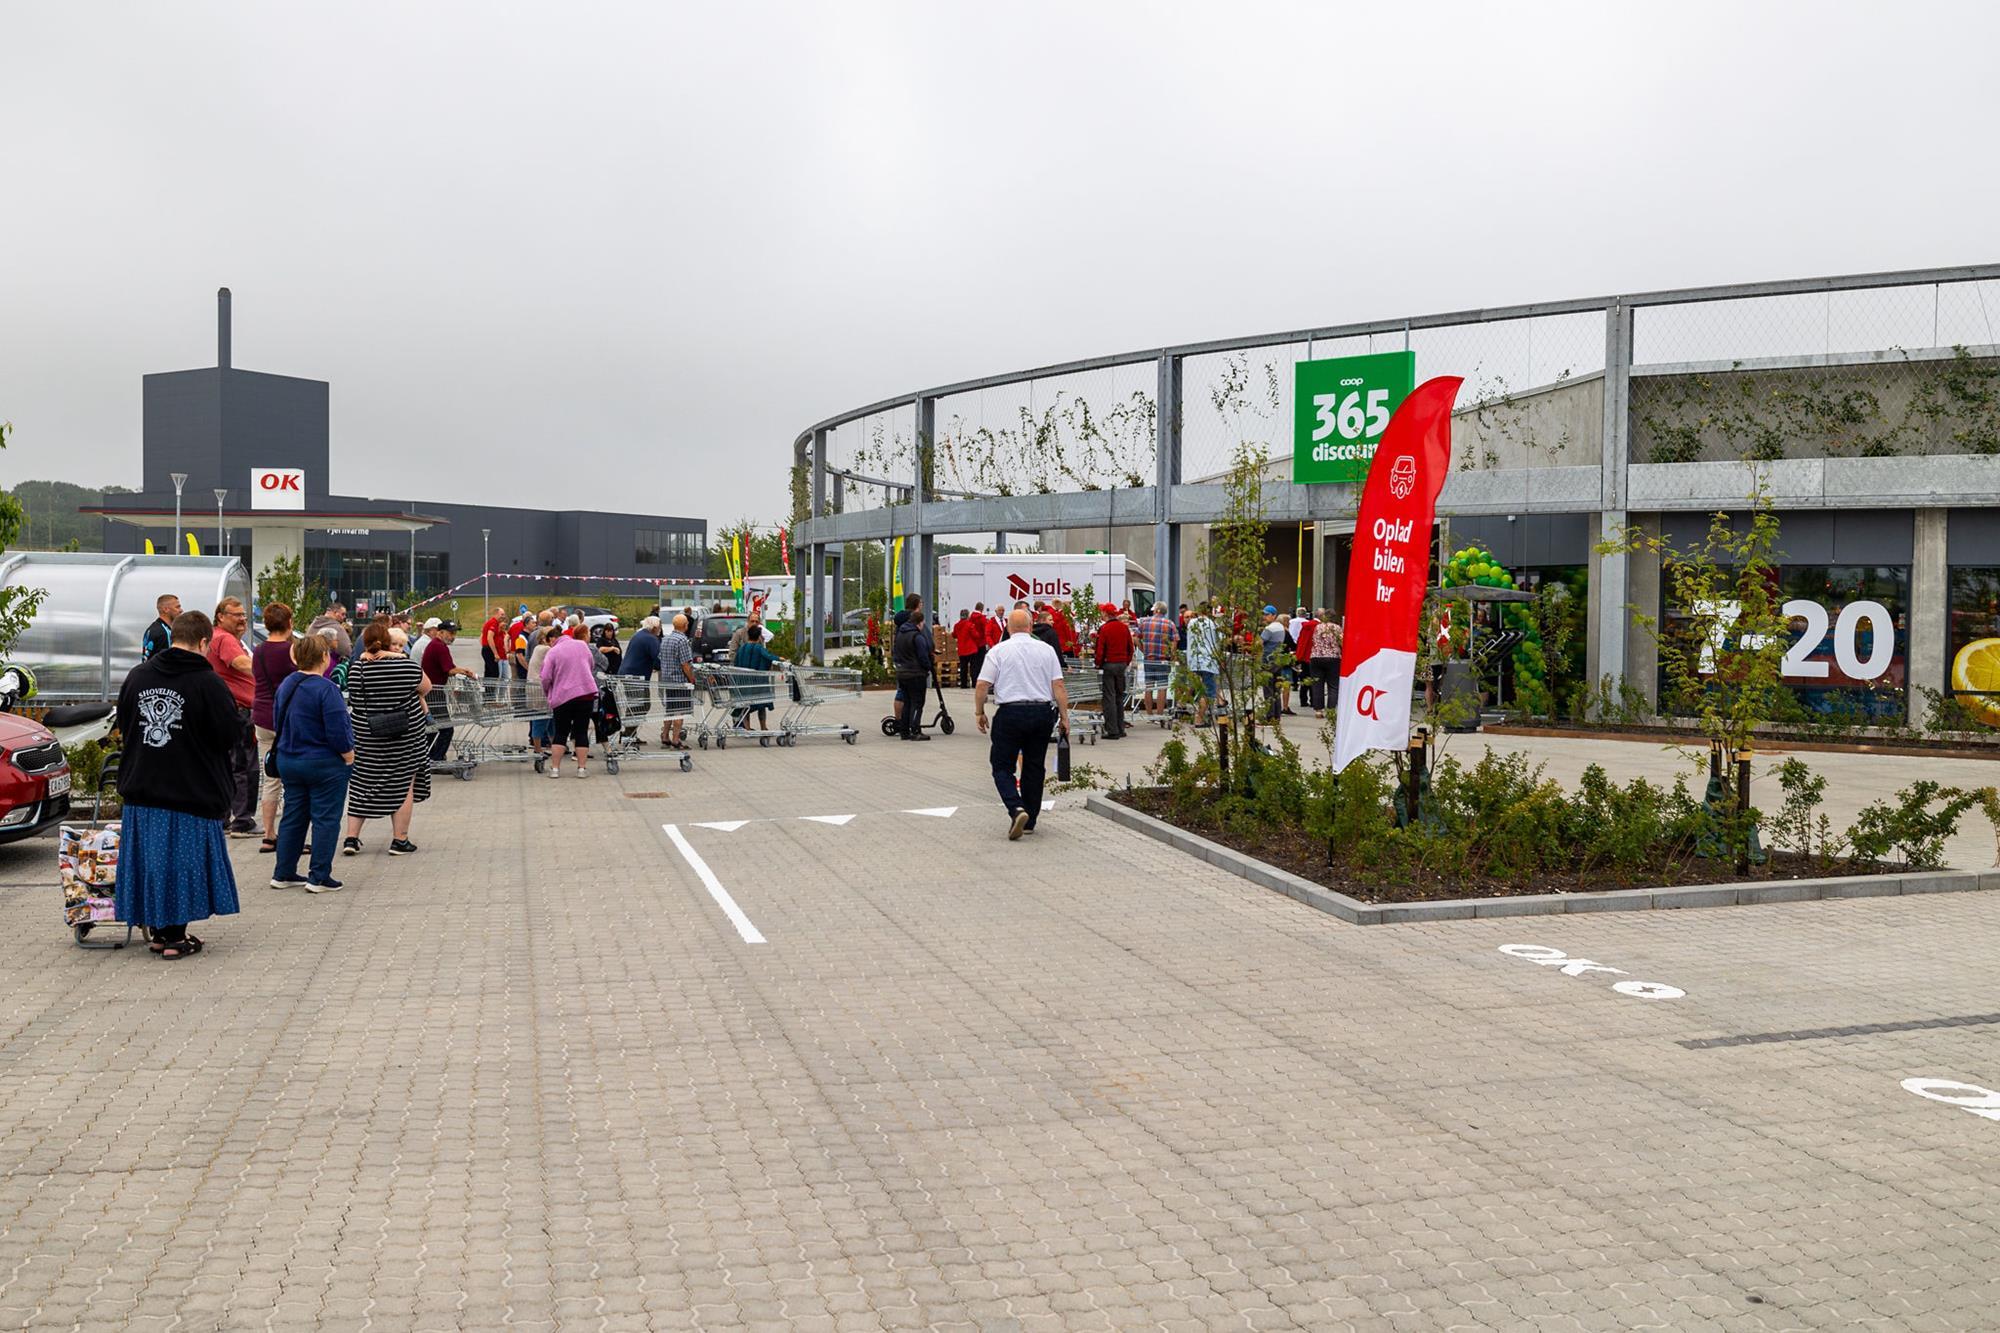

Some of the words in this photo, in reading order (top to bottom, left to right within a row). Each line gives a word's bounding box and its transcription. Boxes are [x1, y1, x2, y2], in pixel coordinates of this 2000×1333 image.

[1340, 378, 1364, 386] coop
[1312, 388, 1391, 442] 365
[1312, 442, 1379, 462] discoun
[260, 473, 300, 491] OK
[1373, 517, 1414, 547] Oplad
[1373, 547, 1405, 574] bilen
[1032, 578, 1072, 595] bals
[138, 687, 185, 705] SHOVELHEAD
